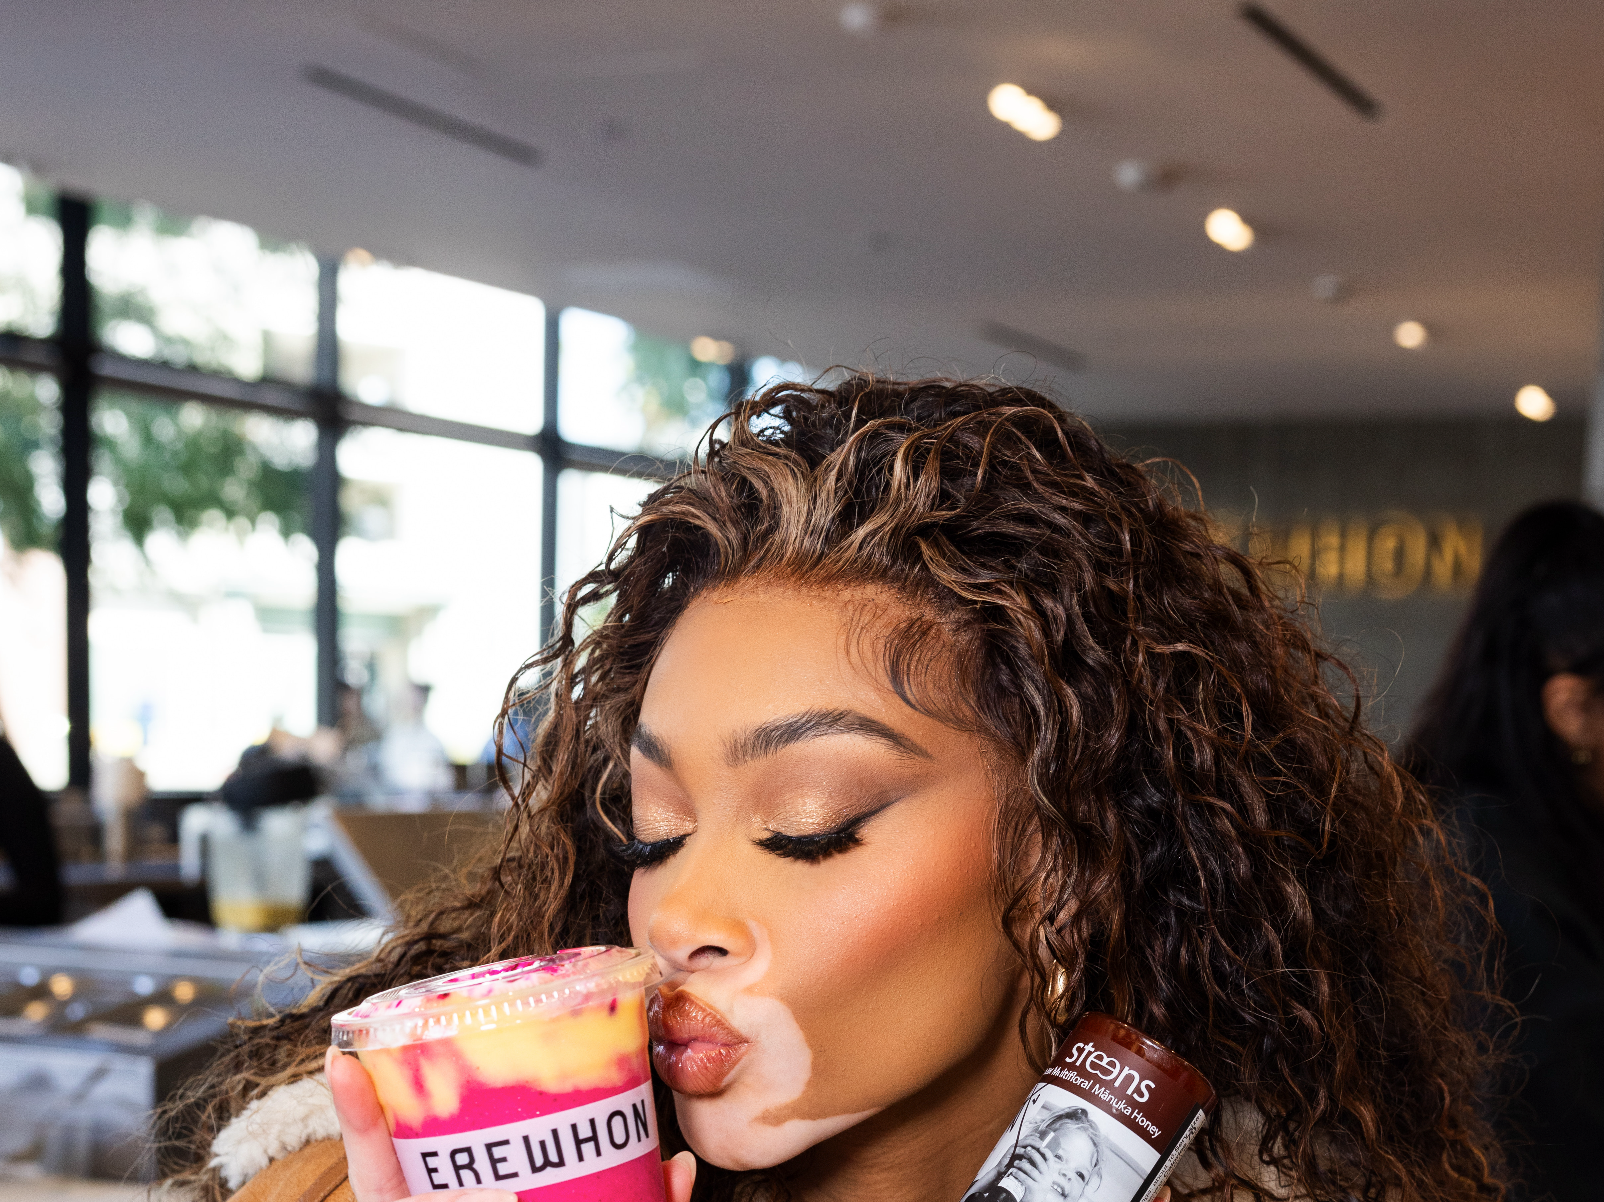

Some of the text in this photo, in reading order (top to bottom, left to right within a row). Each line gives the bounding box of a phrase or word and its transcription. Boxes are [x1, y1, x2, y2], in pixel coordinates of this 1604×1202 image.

[1064, 1041, 1156, 1103] steens
[420, 1098, 650, 1190] EREWHON
[1131, 1109, 1162, 1139] Honey
